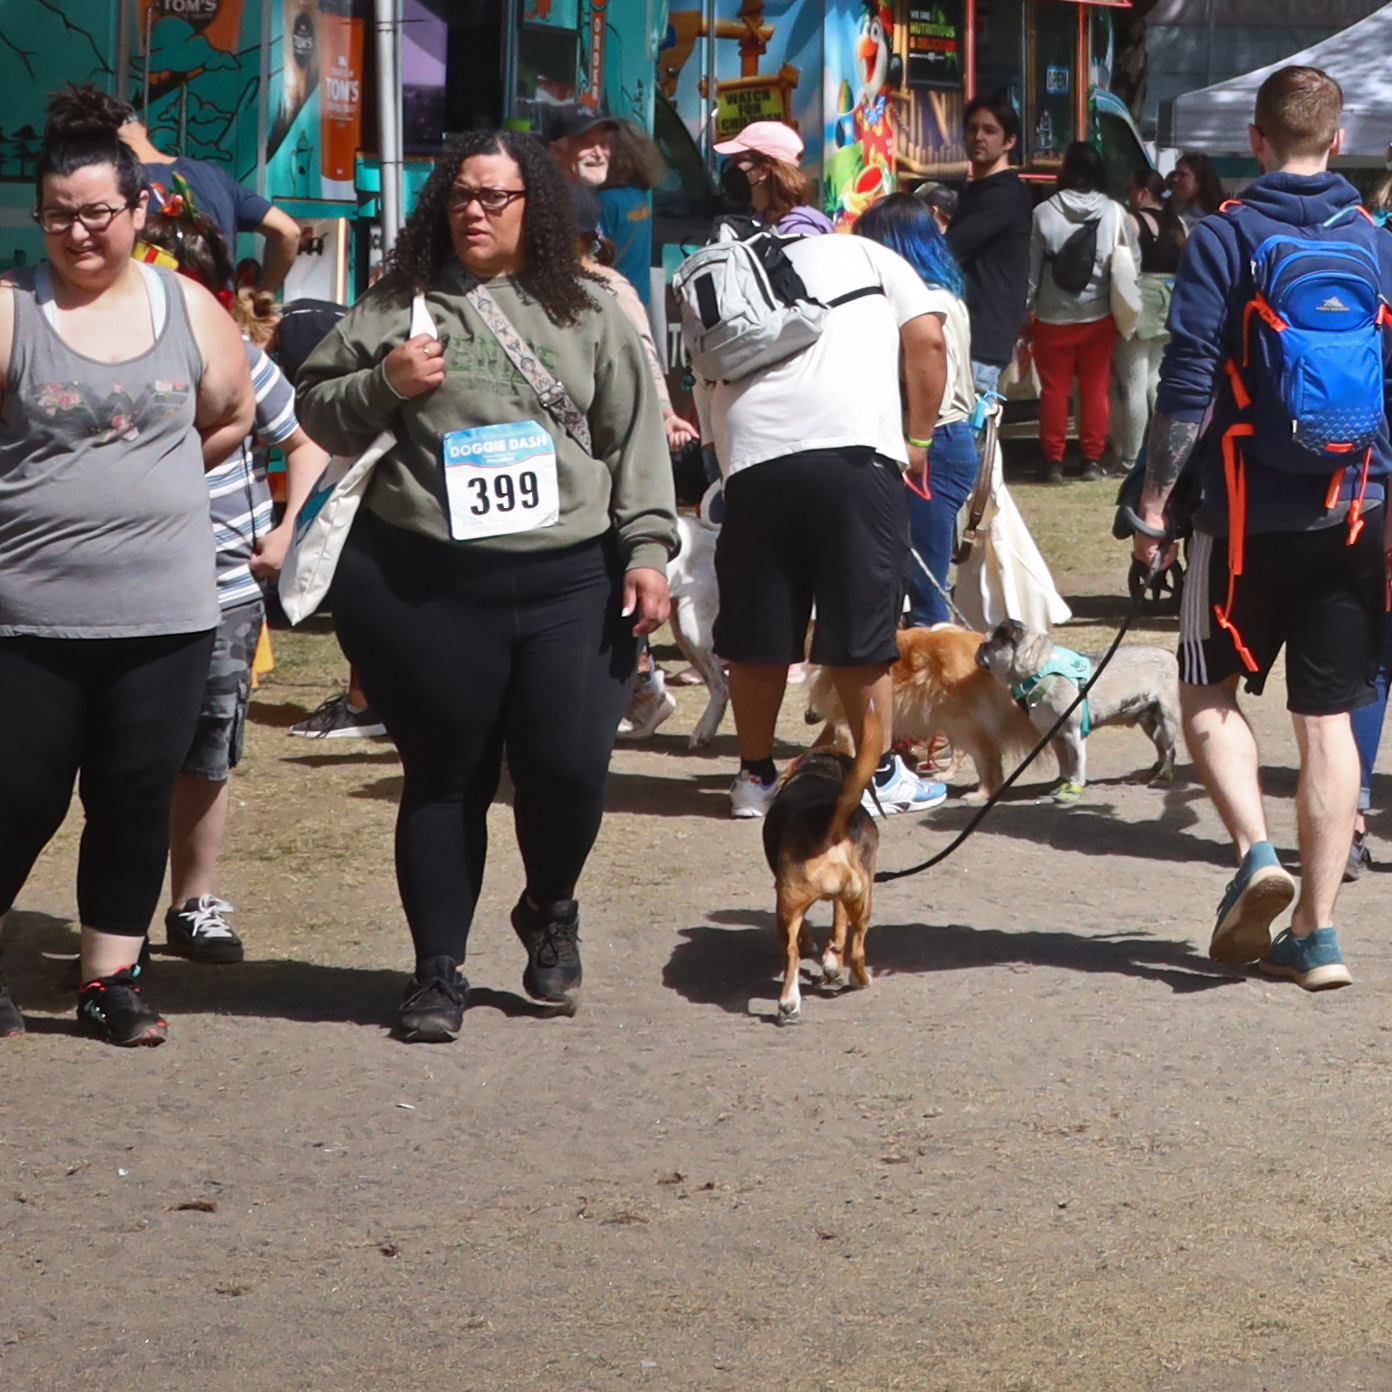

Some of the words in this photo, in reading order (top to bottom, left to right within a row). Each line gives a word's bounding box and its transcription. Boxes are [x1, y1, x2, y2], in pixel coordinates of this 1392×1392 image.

[326, 78, 359, 102] TOM'S
[725, 90, 771, 105] WATCH
[450, 439, 506, 458] DOGGIE
[509, 434, 548, 452] DASH
[467, 471, 540, 516] 399
